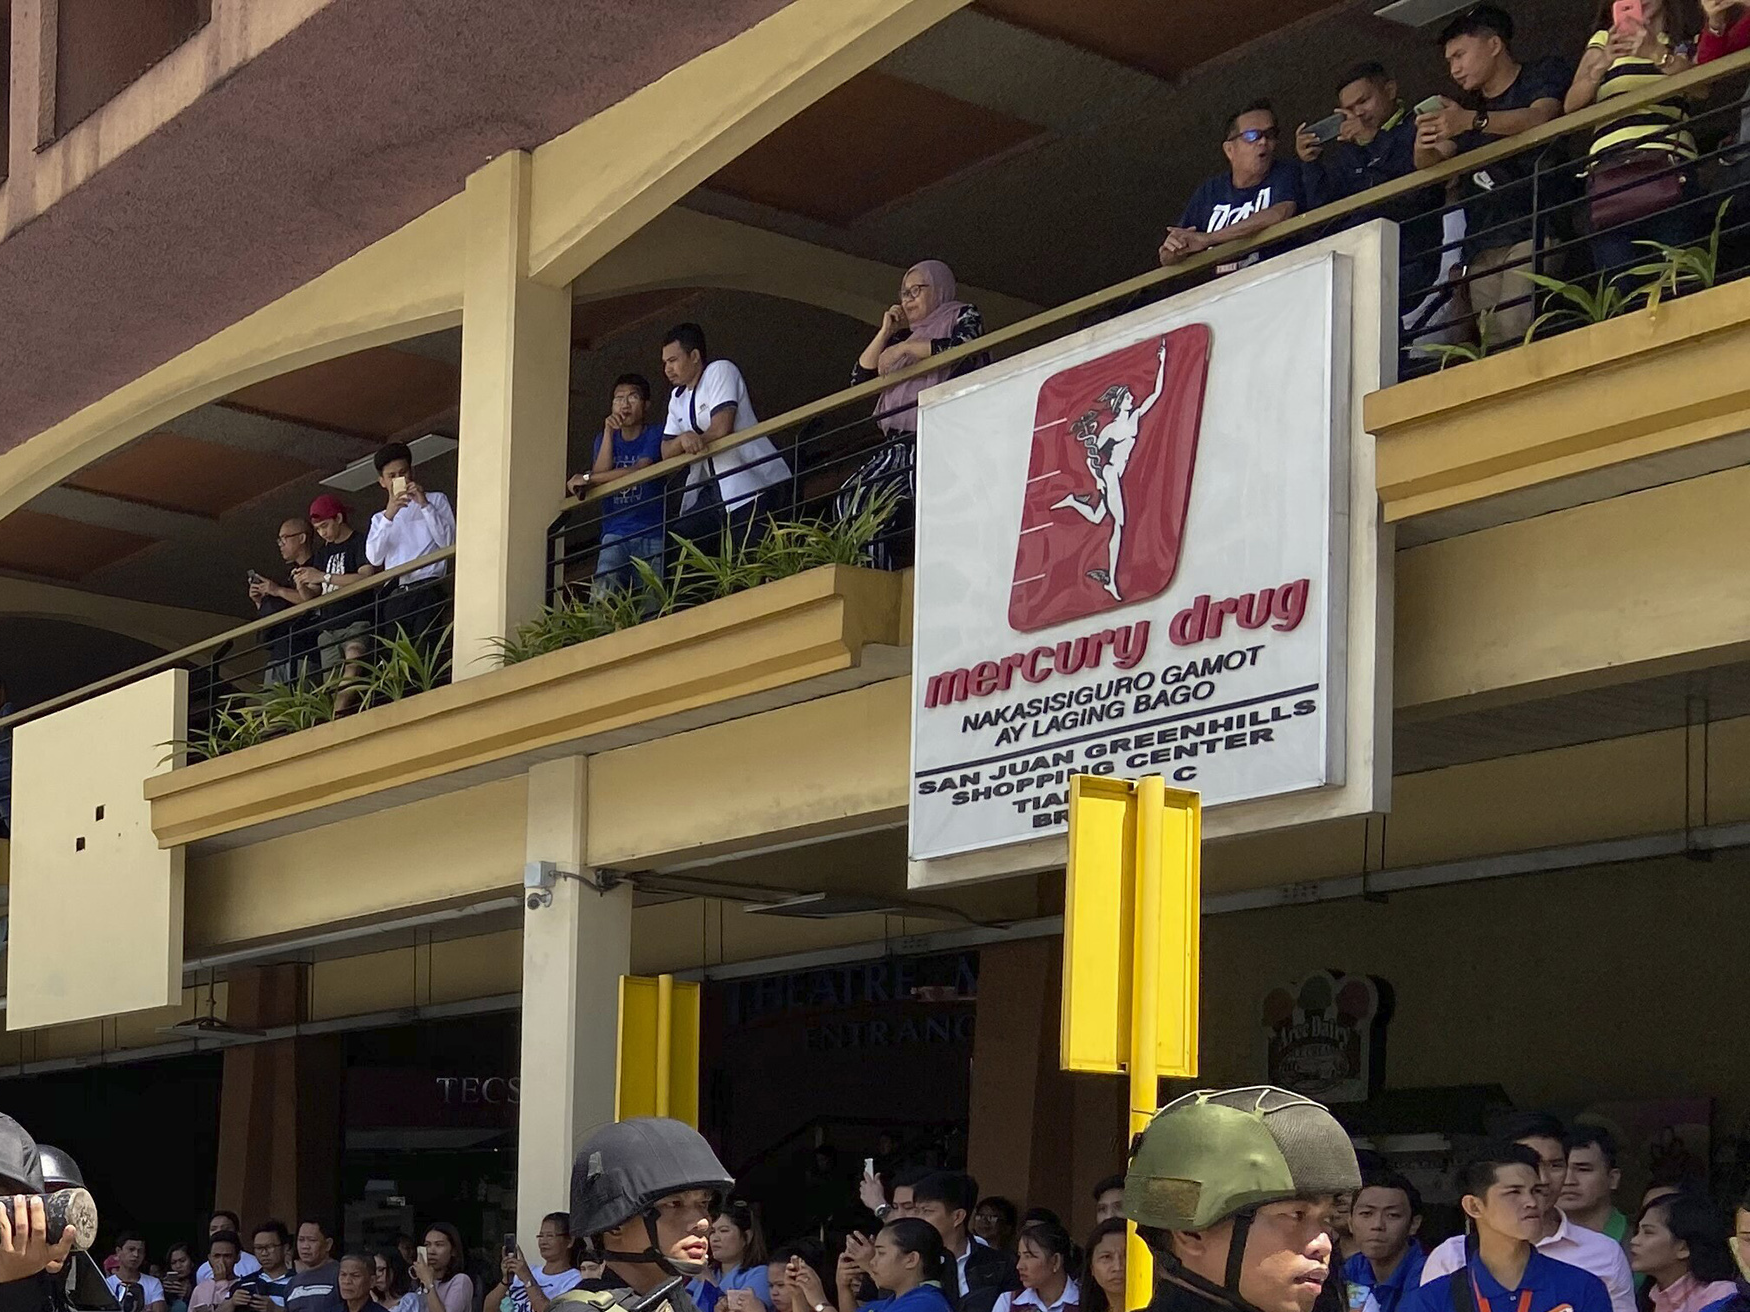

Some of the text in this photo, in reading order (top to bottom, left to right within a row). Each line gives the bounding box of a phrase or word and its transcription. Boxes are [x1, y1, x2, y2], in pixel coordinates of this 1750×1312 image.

[924, 578, 1310, 708] mercury drug
[962, 645, 1265, 732] NAKASISIGURO GAMOT
[995, 681, 1215, 747] AY LAGING BAGO
[919, 699, 1317, 795] SAN JUAN GREENHILLS
[952, 727, 1274, 806] SHOPPING CENTER
[1173, 766, 1197, 782] C
[806, 1013, 977, 1049] ENTRANC
[436, 1076, 520, 1104] TECS
